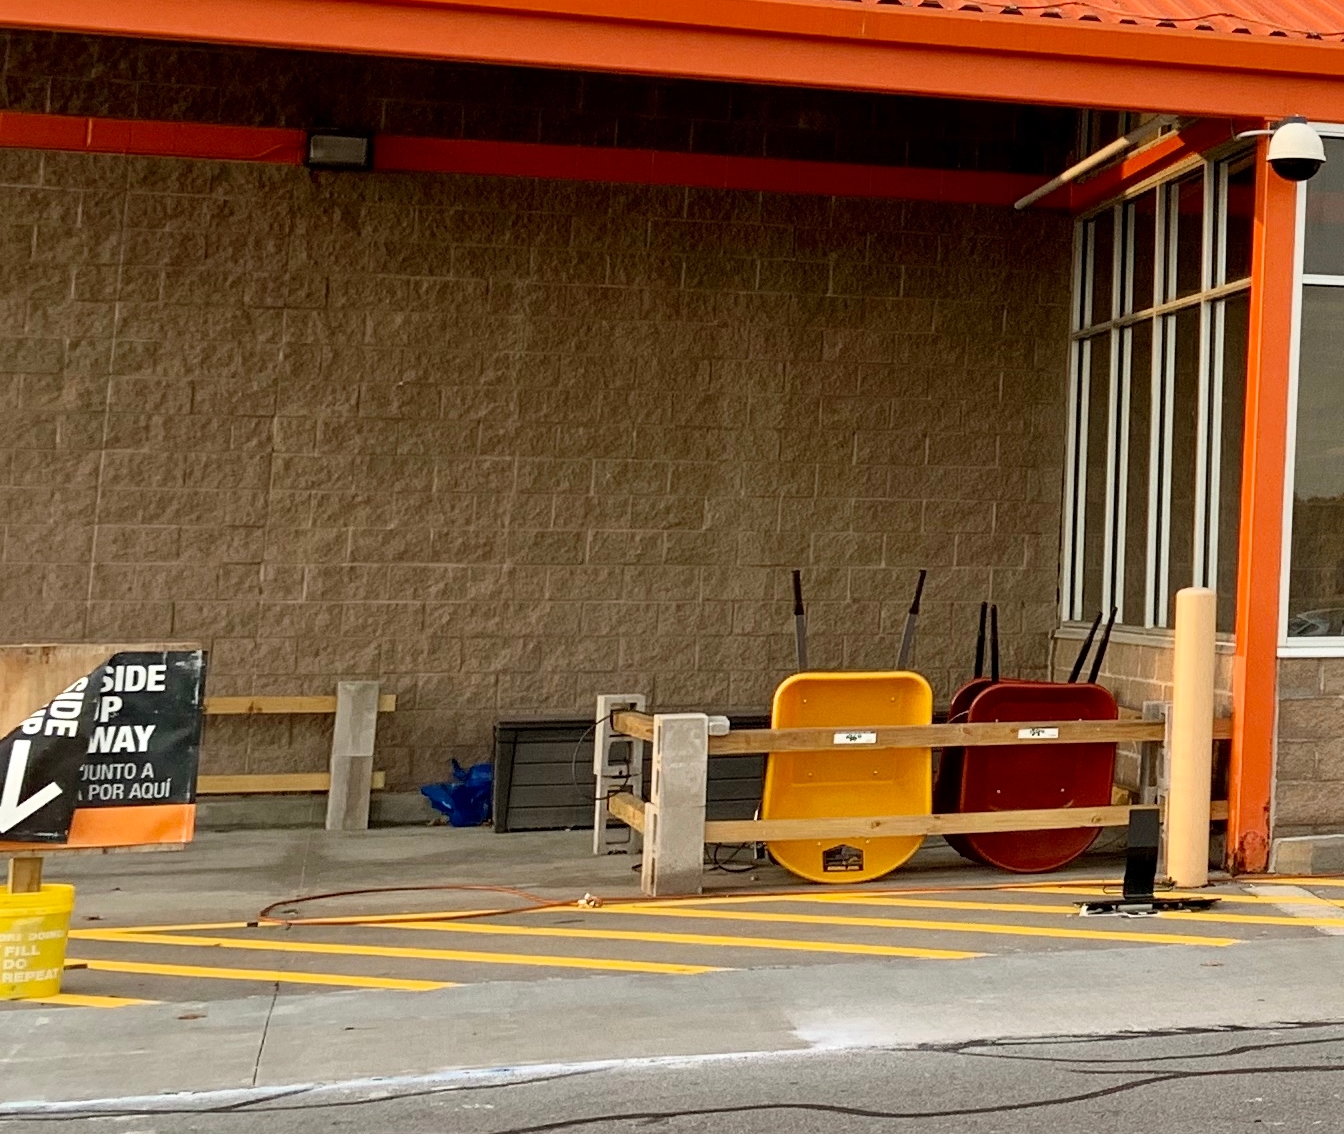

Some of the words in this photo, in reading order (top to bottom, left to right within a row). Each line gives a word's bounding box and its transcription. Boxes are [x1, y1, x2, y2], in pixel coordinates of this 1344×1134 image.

[100, 664, 168, 693] SIDE
[93, 696, 123, 723] P
[87, 725, 156, 754] WAY
[141, 763, 154, 779] A
[88, 784, 124, 801] POR
[129, 777, 172, 799] AQUÍ
[3, 944, 41, 957] FILL
[3, 958, 27, 970] DO
[1, 967, 59, 983] REPEAT
